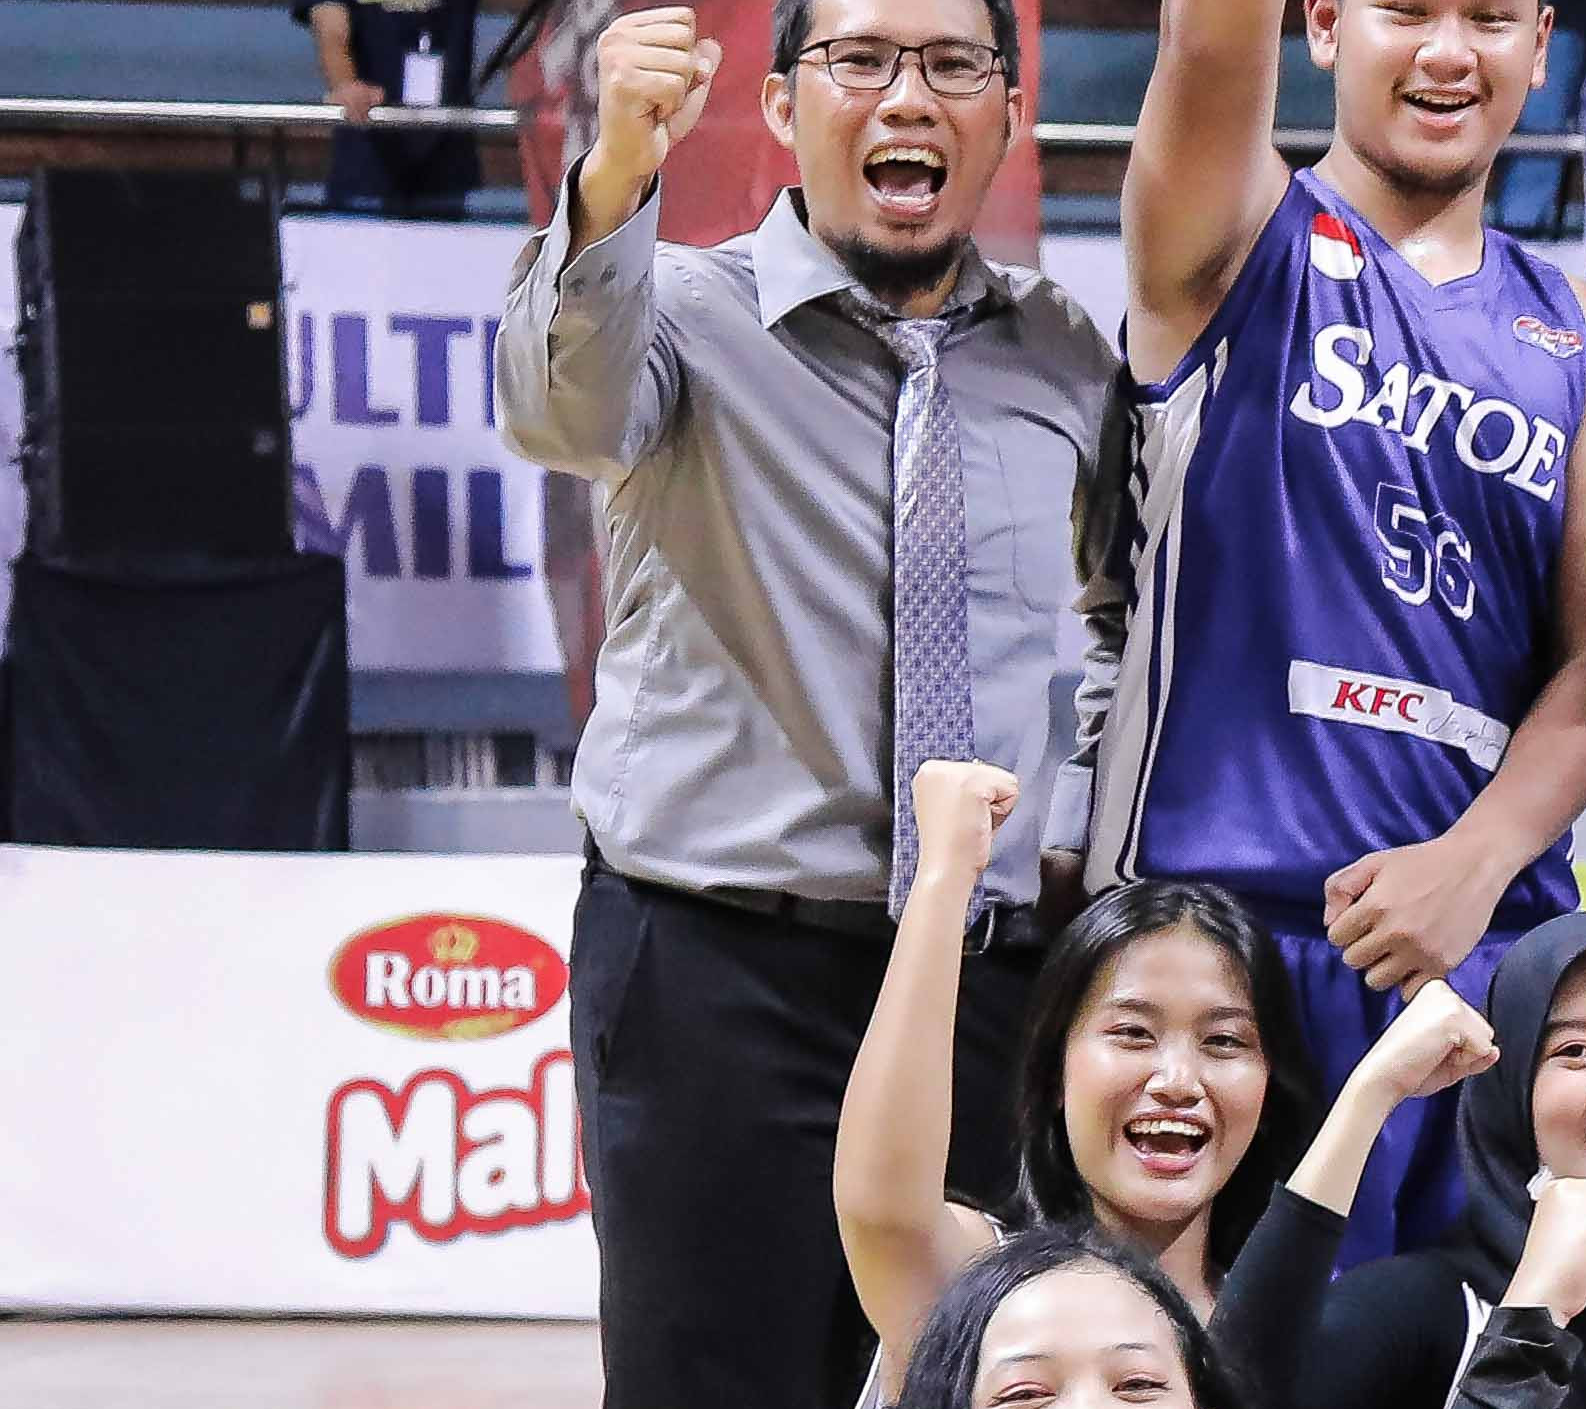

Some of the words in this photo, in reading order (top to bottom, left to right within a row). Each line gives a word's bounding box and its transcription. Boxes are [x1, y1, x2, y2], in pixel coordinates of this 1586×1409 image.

[1289, 323, 1567, 502] SATOE
[1374, 481, 1477, 622] 56
[1332, 680, 1425, 724] KFC
[363, 950, 538, 1011] Roma
[325, 1050, 592, 1258] Mal
